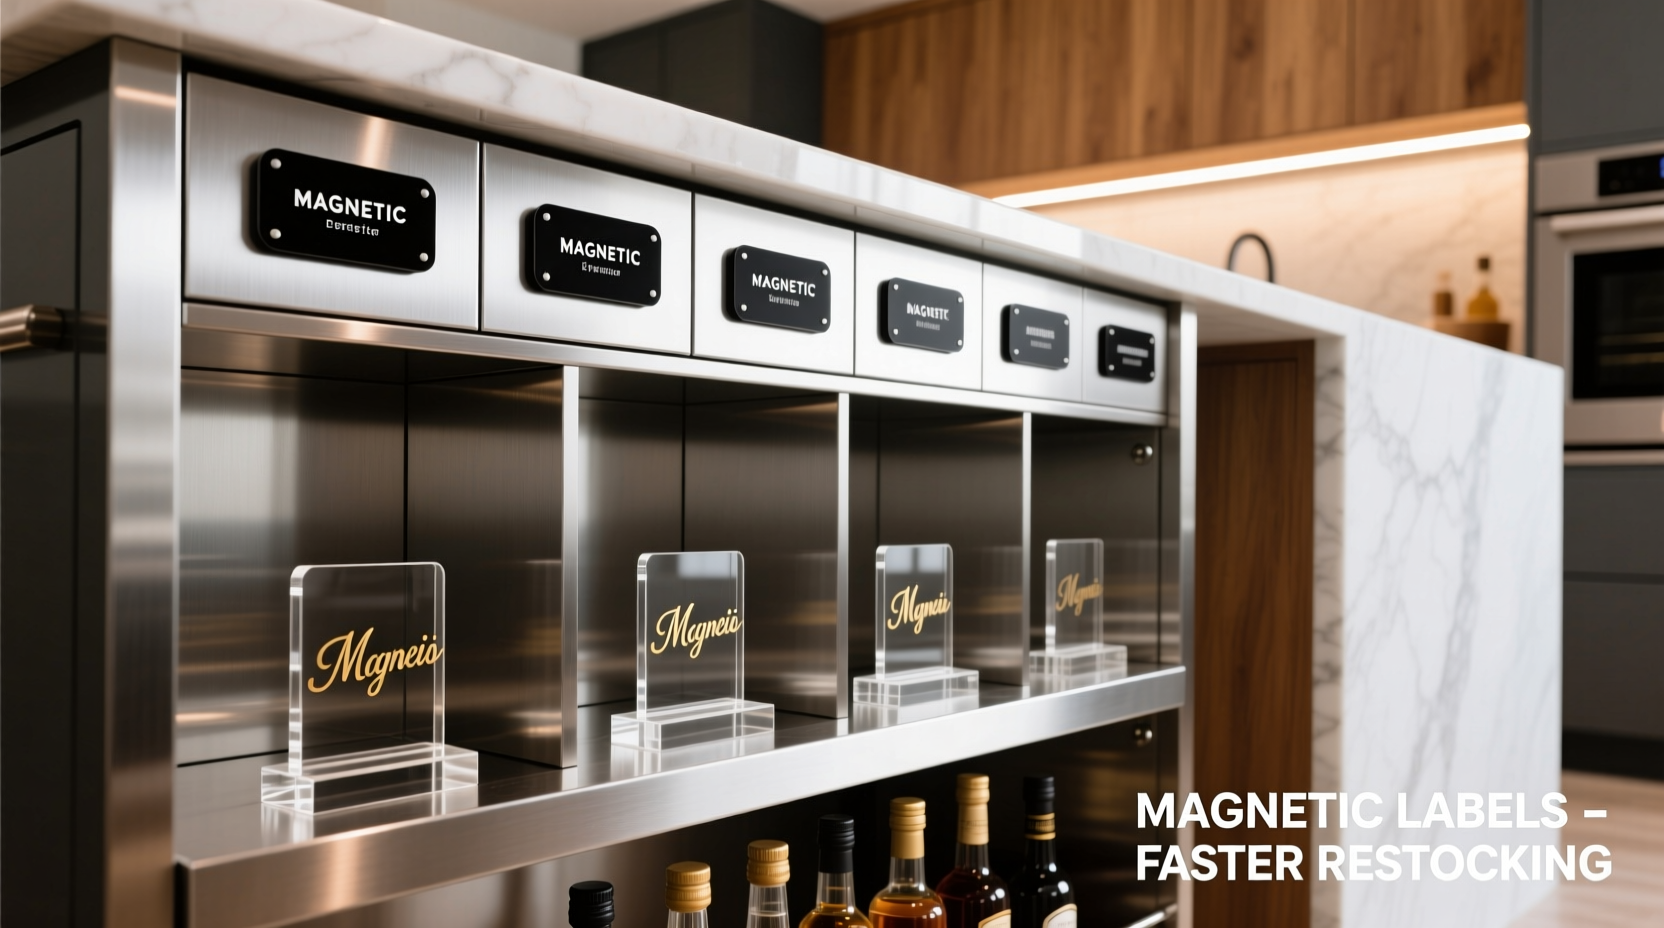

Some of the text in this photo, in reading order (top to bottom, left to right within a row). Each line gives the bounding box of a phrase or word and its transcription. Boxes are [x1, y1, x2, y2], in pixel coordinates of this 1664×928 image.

[294, 188, 407, 224] MAGNETIC
[560, 236, 641, 266] MAGNETIC
[752, 273, 816, 298] MAGNETIC
